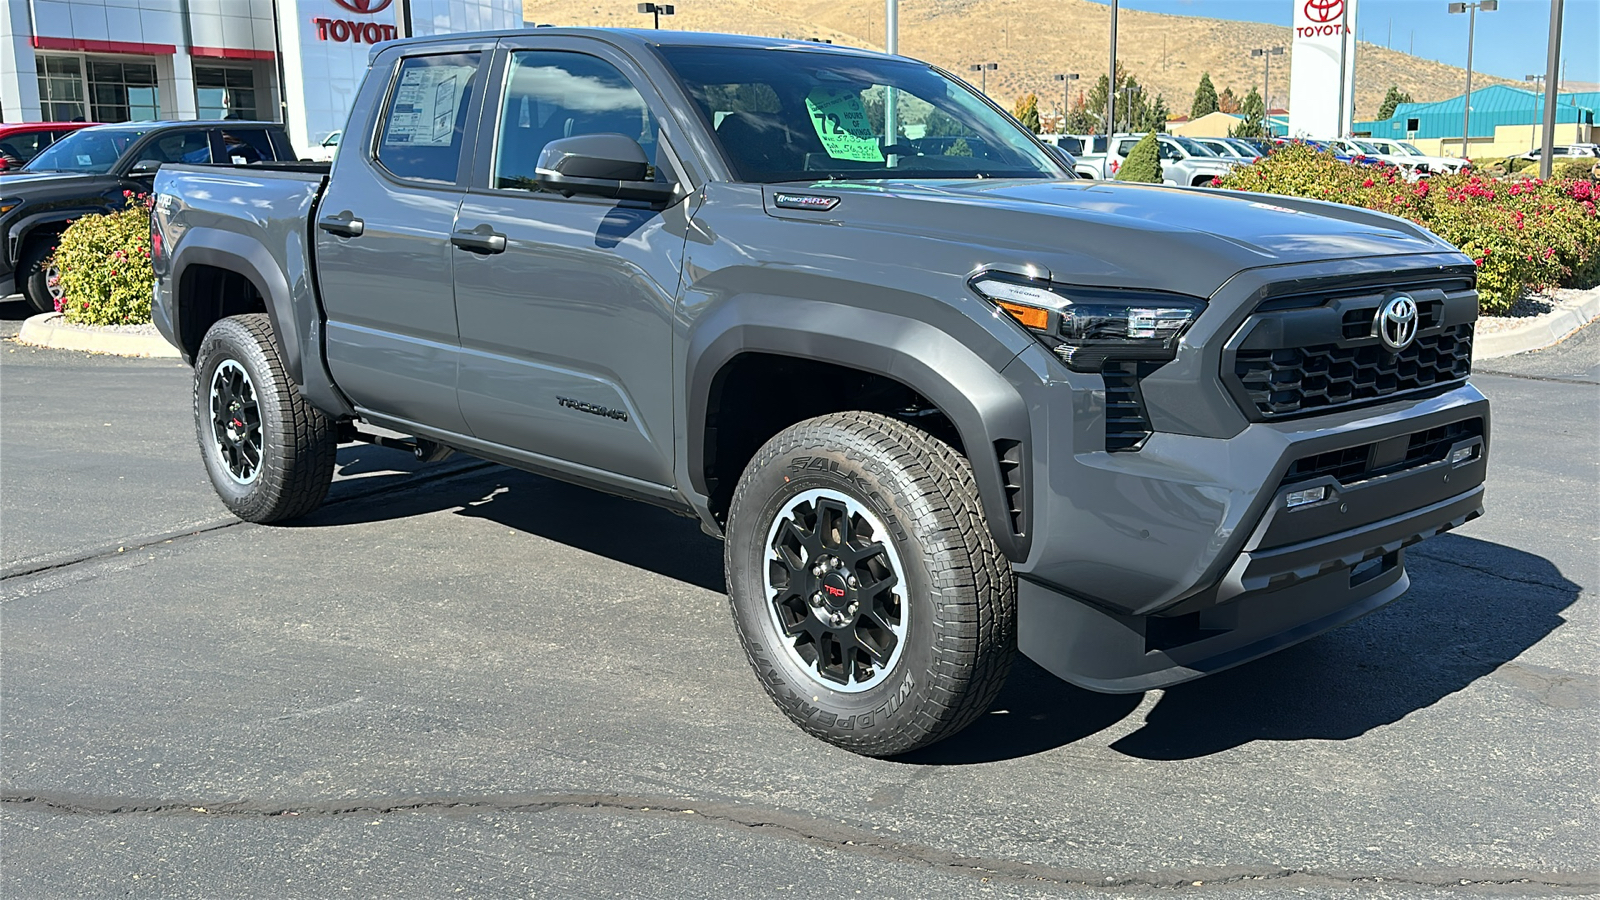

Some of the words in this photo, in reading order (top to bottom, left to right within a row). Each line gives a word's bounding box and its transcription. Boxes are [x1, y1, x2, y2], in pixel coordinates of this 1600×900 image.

[814, 113, 844, 134] 72
[846, 128, 871, 136] SAVINGS
[1009, 288, 1040, 299] TACOMA
[556, 395, 628, 422] TACOMA
[824, 584, 845, 597] TRD
[783, 668, 916, 731] WILDPEAK
